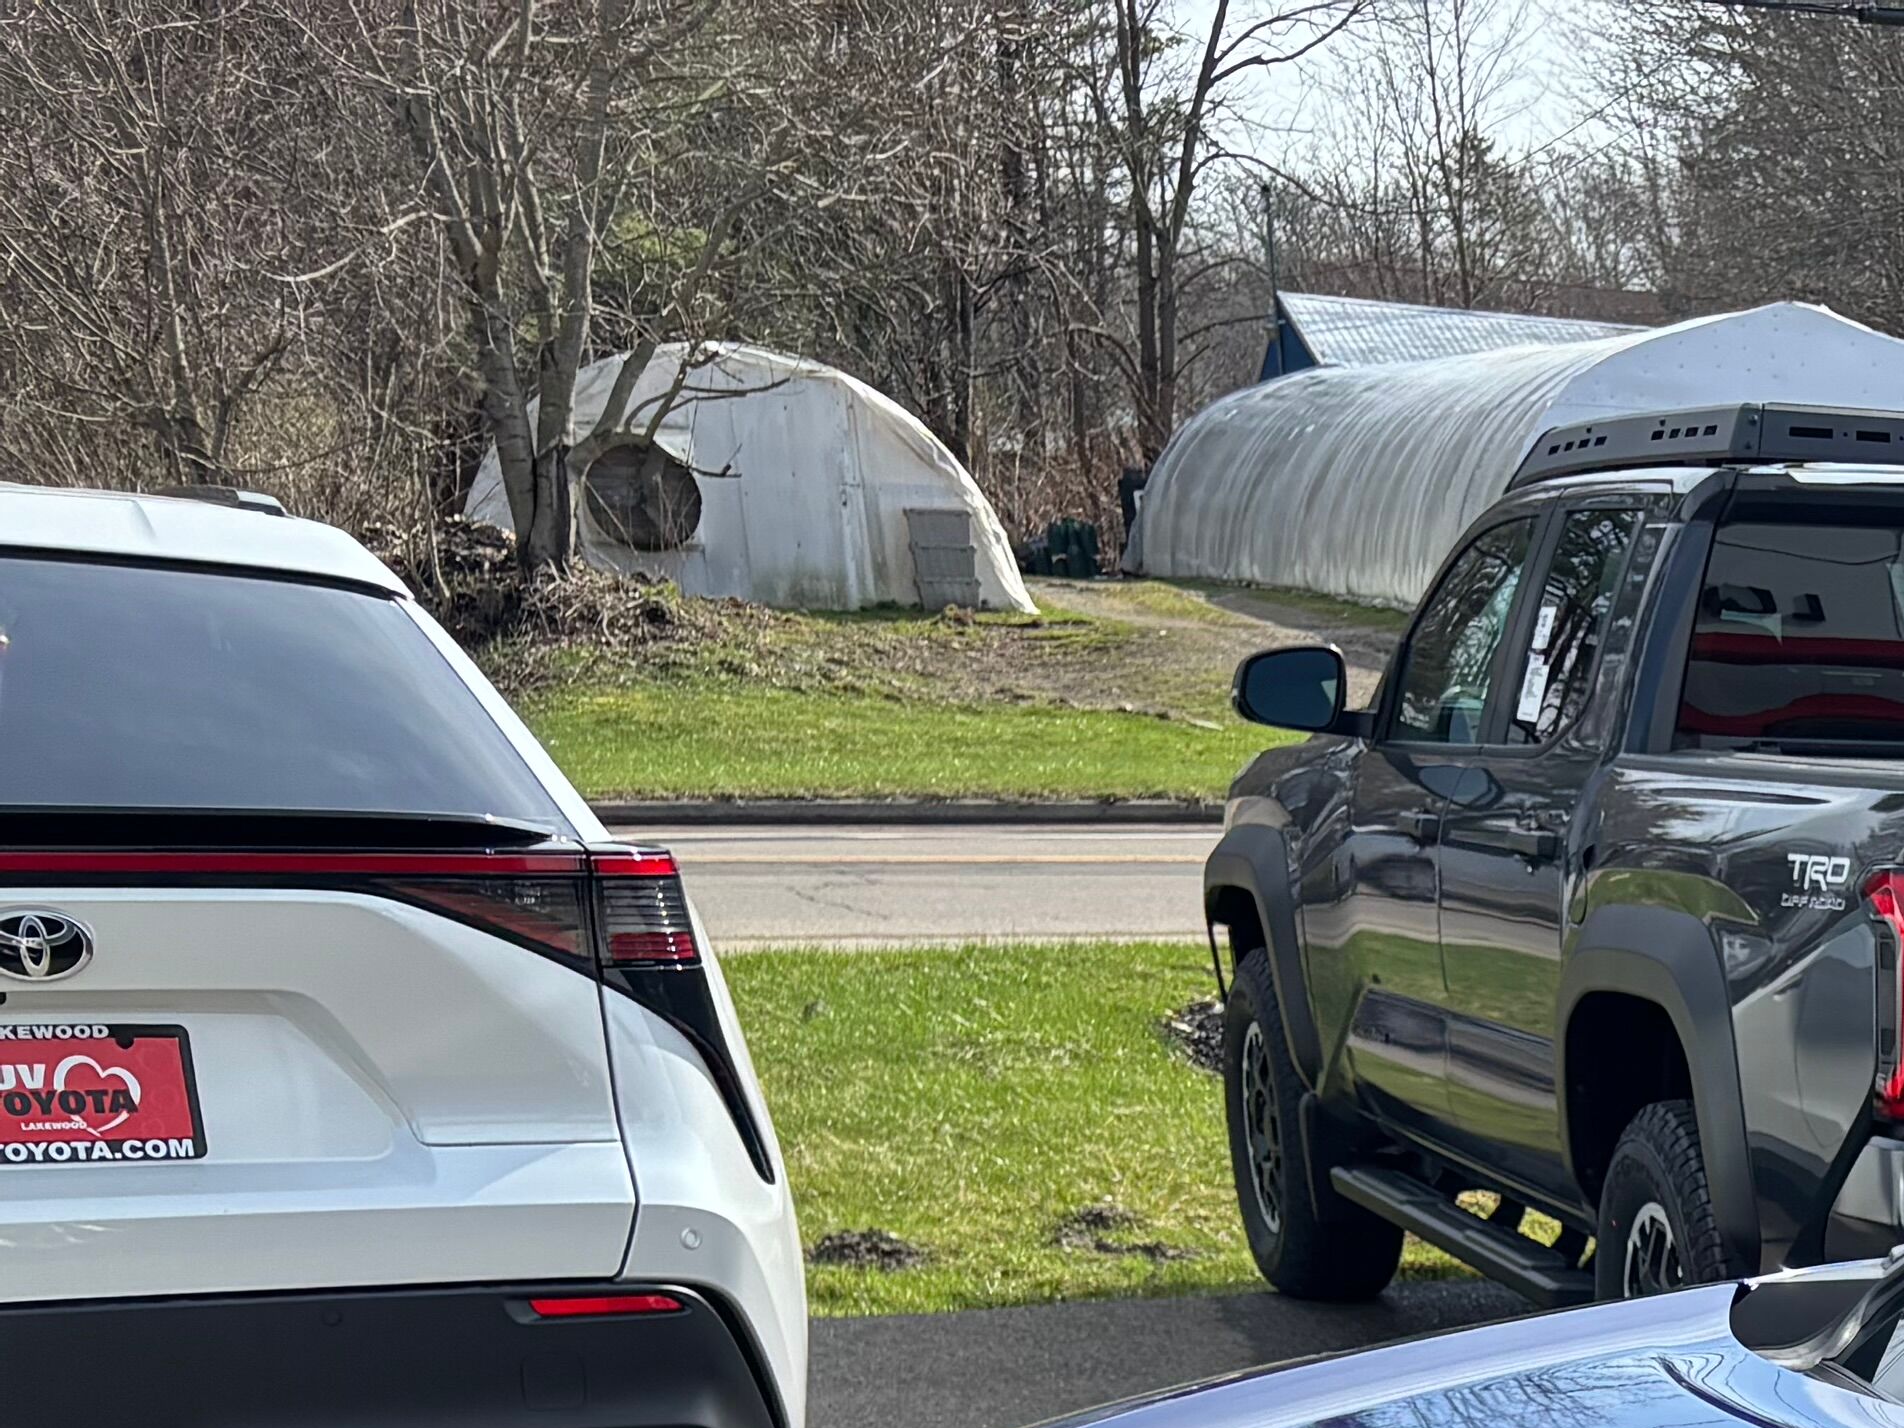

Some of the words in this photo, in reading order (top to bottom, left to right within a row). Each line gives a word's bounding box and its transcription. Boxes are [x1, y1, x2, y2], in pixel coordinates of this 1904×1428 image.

[1787, 853, 1850, 891] TRD
[0, 1064, 46, 1089] UV
[20, 1121, 87, 1131] LAKEWOOD
[0, 1139, 195, 1162] OYOTA.COM
